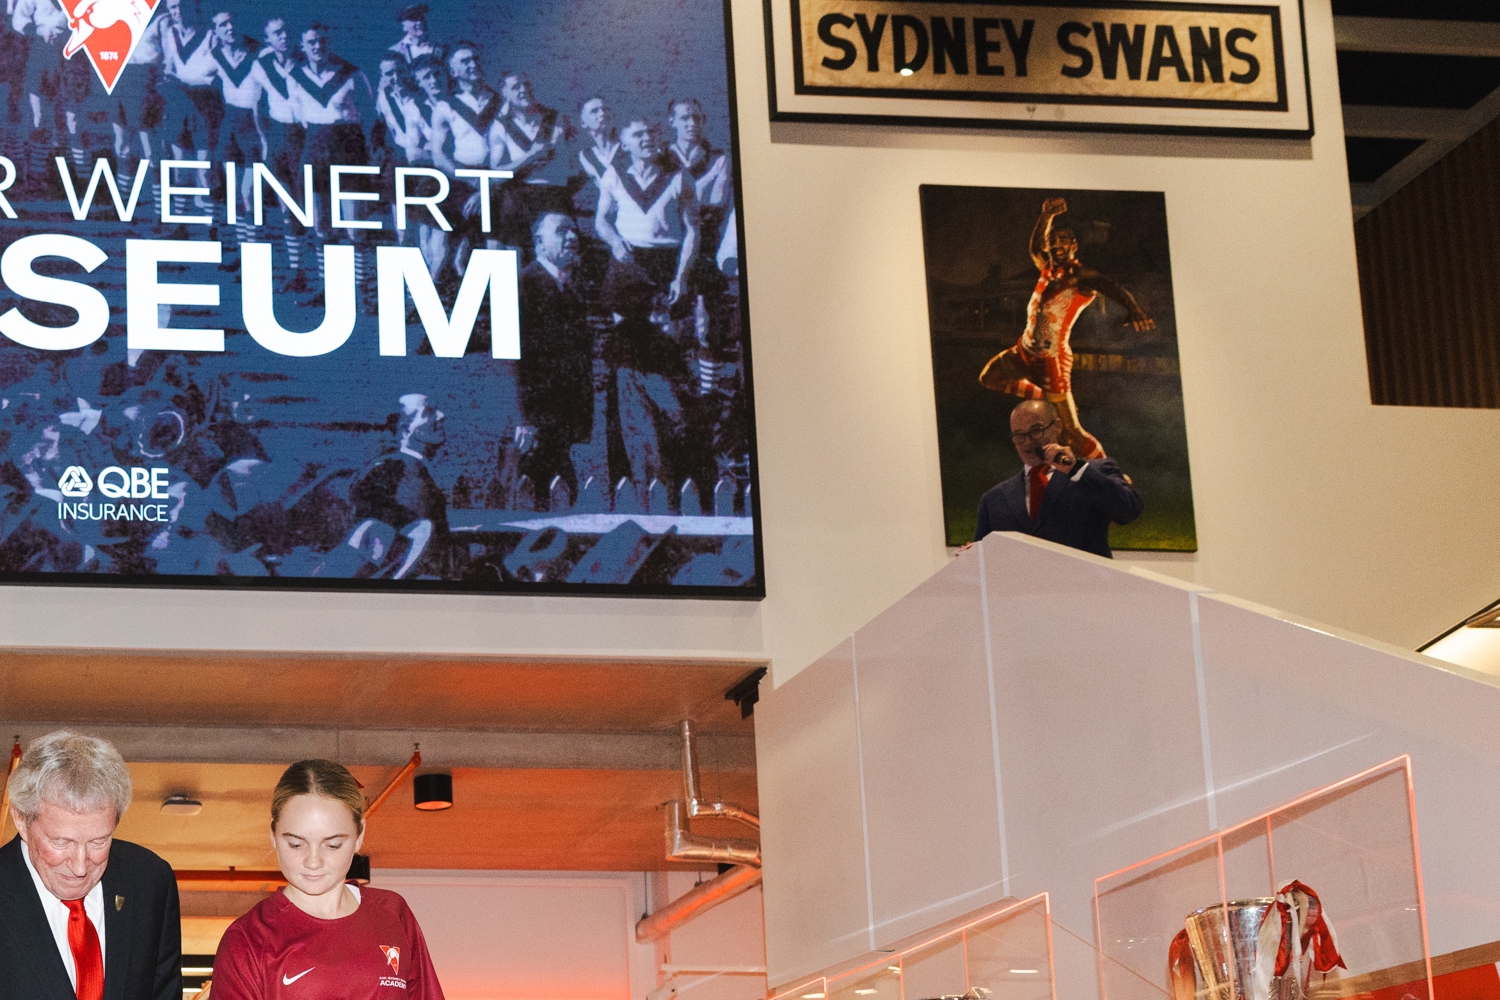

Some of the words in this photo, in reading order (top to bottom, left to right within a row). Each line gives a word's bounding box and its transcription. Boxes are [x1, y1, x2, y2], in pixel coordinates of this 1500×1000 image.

[99, 51, 119, 61] 1874
[817, 12, 1035, 77] SYDNEY
[1056, 21, 1261, 85] SWANS
[56, 156, 514, 234] WEINERT
[97, 466, 169, 500] QBE
[58, 501, 169, 523] INSURANCE
